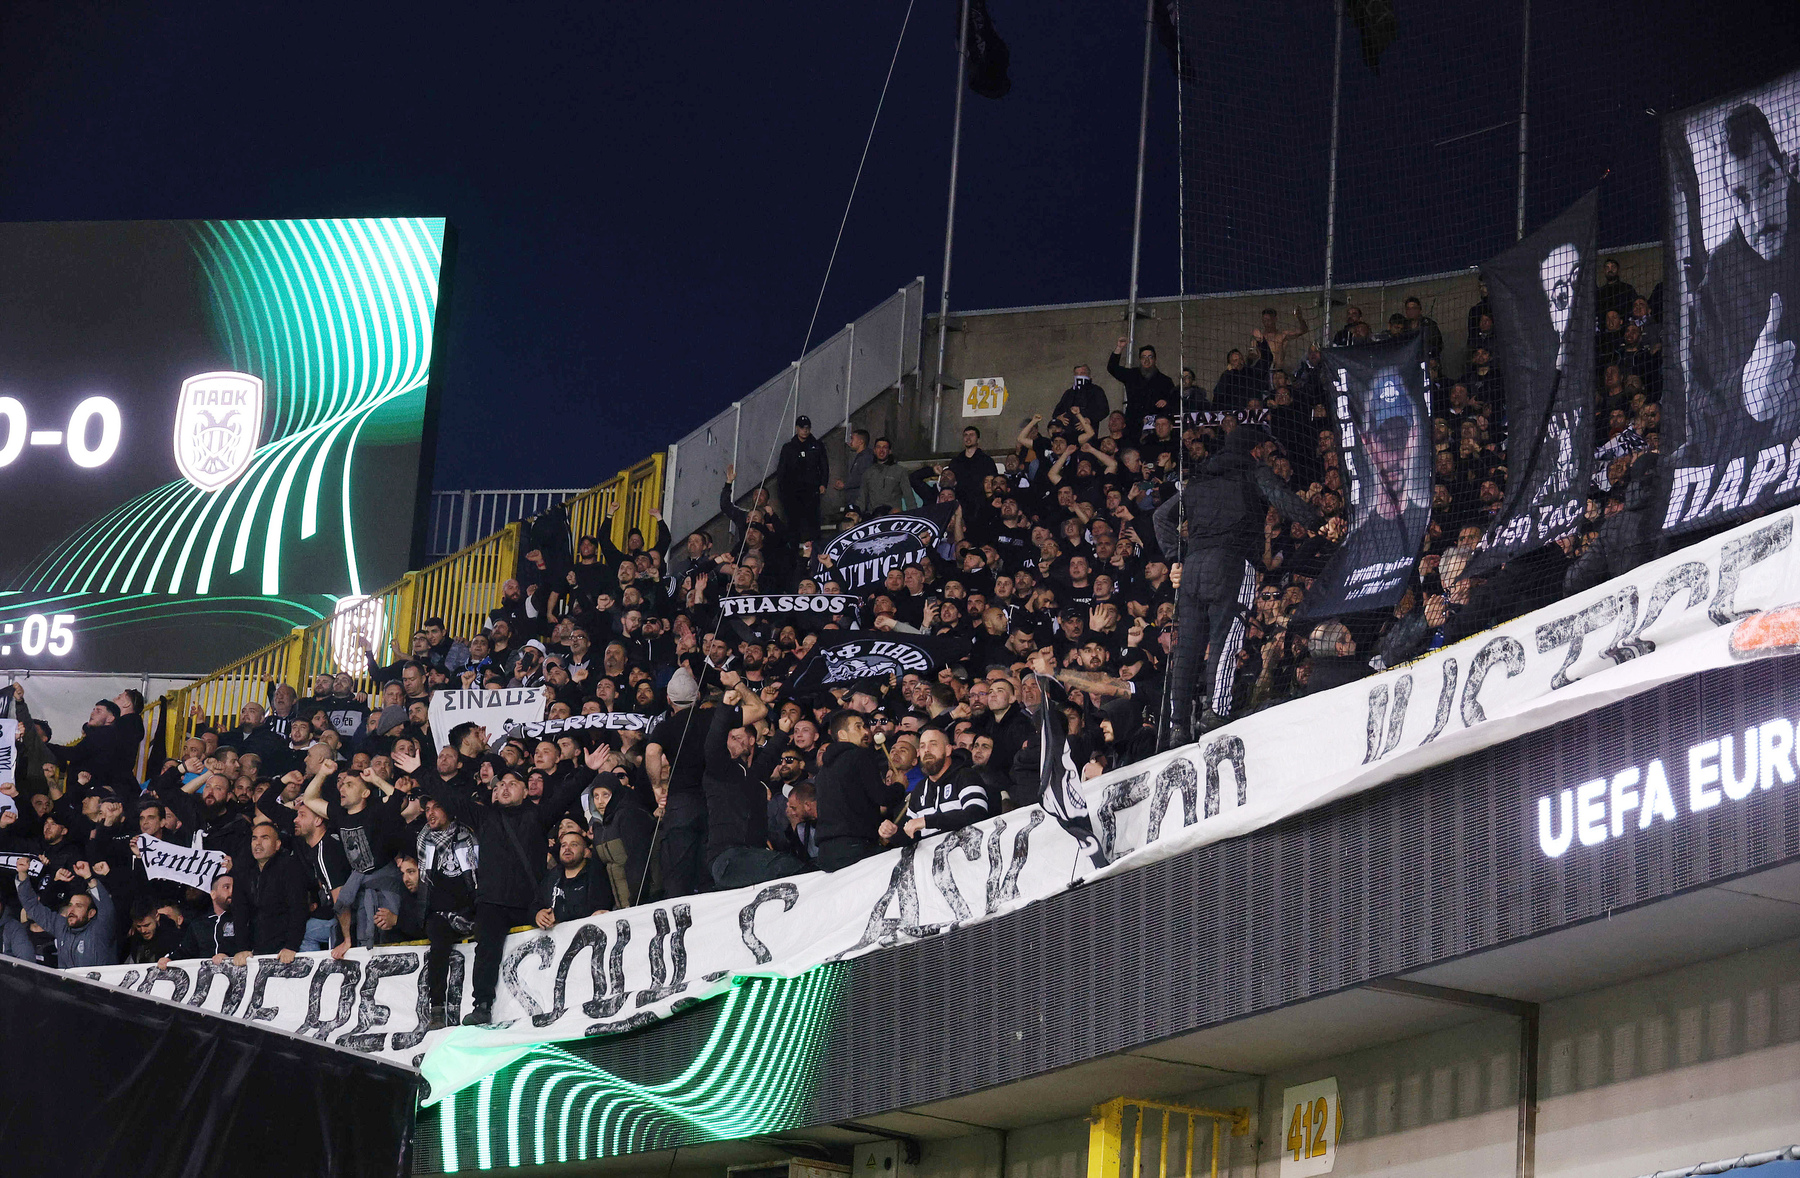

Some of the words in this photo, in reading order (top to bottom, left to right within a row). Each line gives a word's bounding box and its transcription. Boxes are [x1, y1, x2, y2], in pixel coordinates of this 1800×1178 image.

[193, 390, 248, 405] ΠΑΟΚ
[967, 385, 998, 409] 421
[890, 521, 933, 540] CLU
[720, 596, 846, 617] THASSOS
[526, 711, 649, 738] SERRES
[1538, 758, 1677, 858] UEFA
[1688, 717, 1800, 813] EUR
[1286, 1096, 1329, 1162] 412
